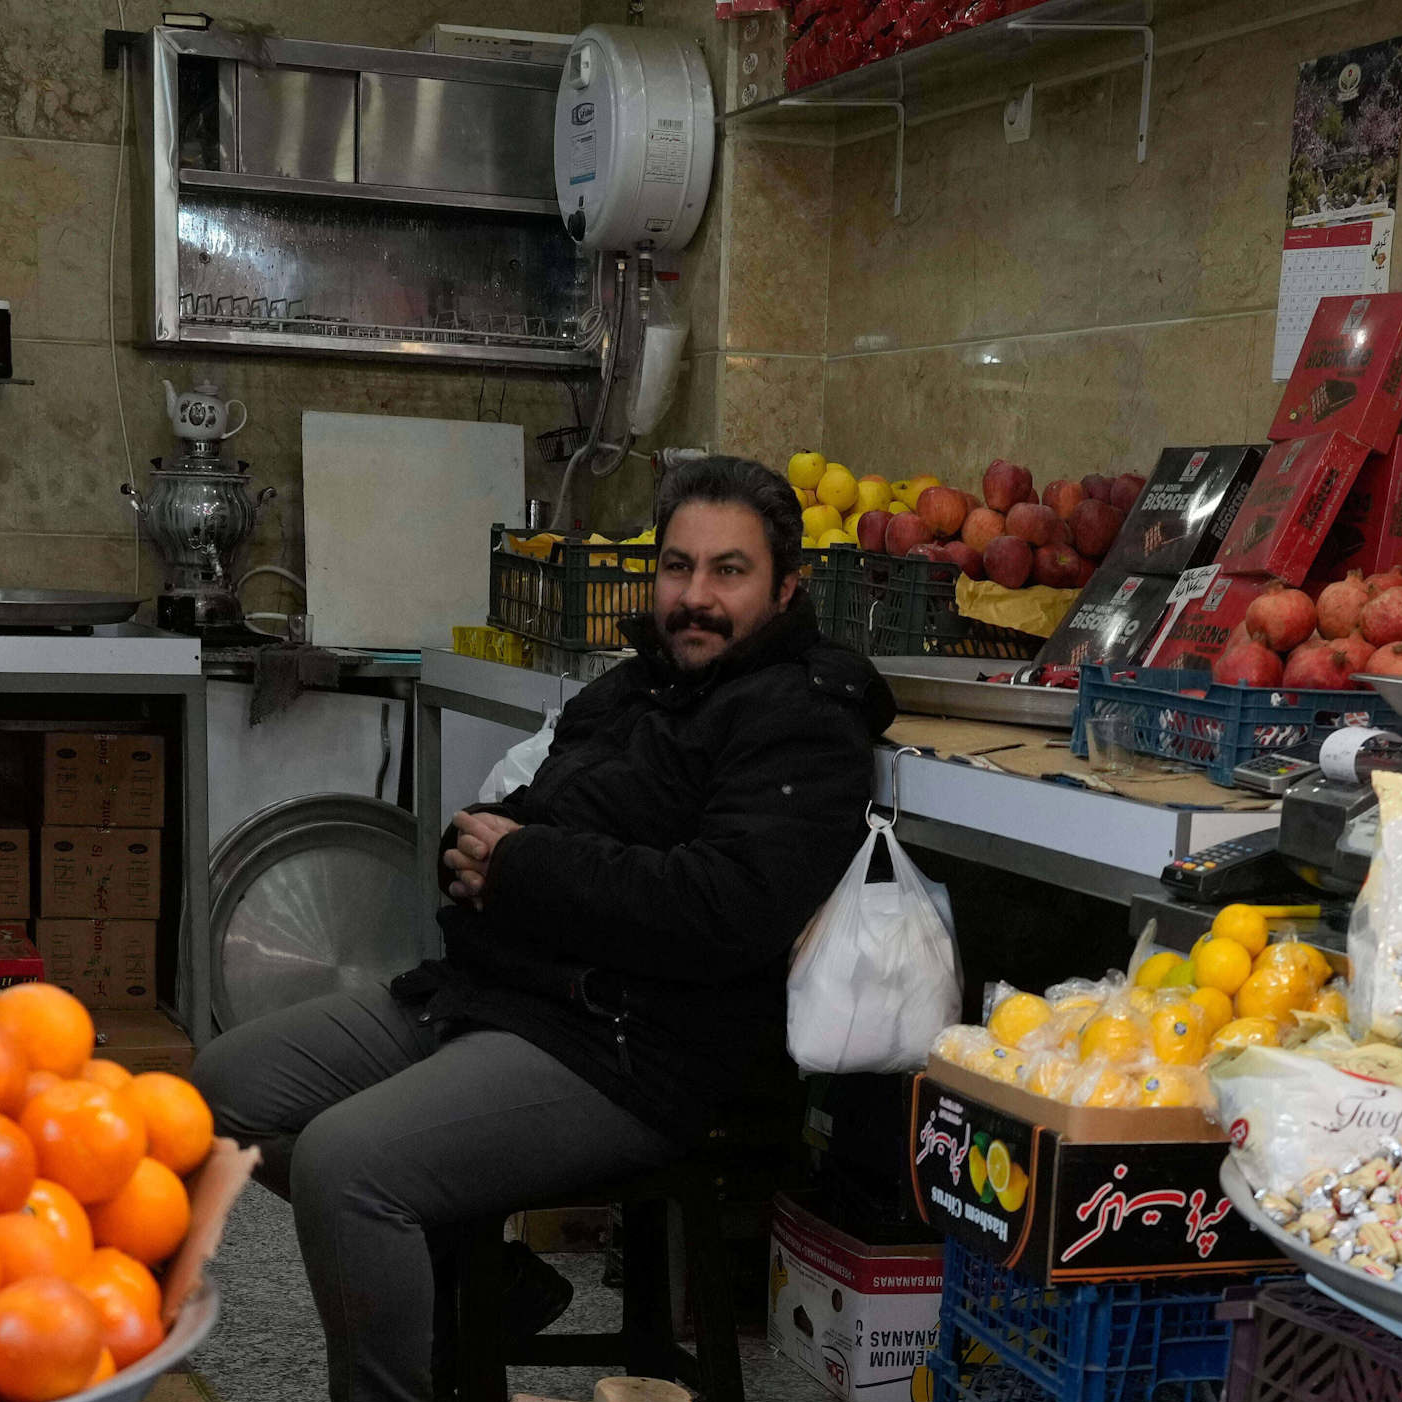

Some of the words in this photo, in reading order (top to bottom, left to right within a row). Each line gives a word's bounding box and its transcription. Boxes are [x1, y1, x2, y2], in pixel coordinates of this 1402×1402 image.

[930, 1185, 964, 1218] Citrus
[963, 1203, 1009, 1243] Hashem
[873, 1275, 924, 1288] BANANAS
[870, 1330, 940, 1347] ANANAS
[869, 1350, 926, 1368] EMIUM
